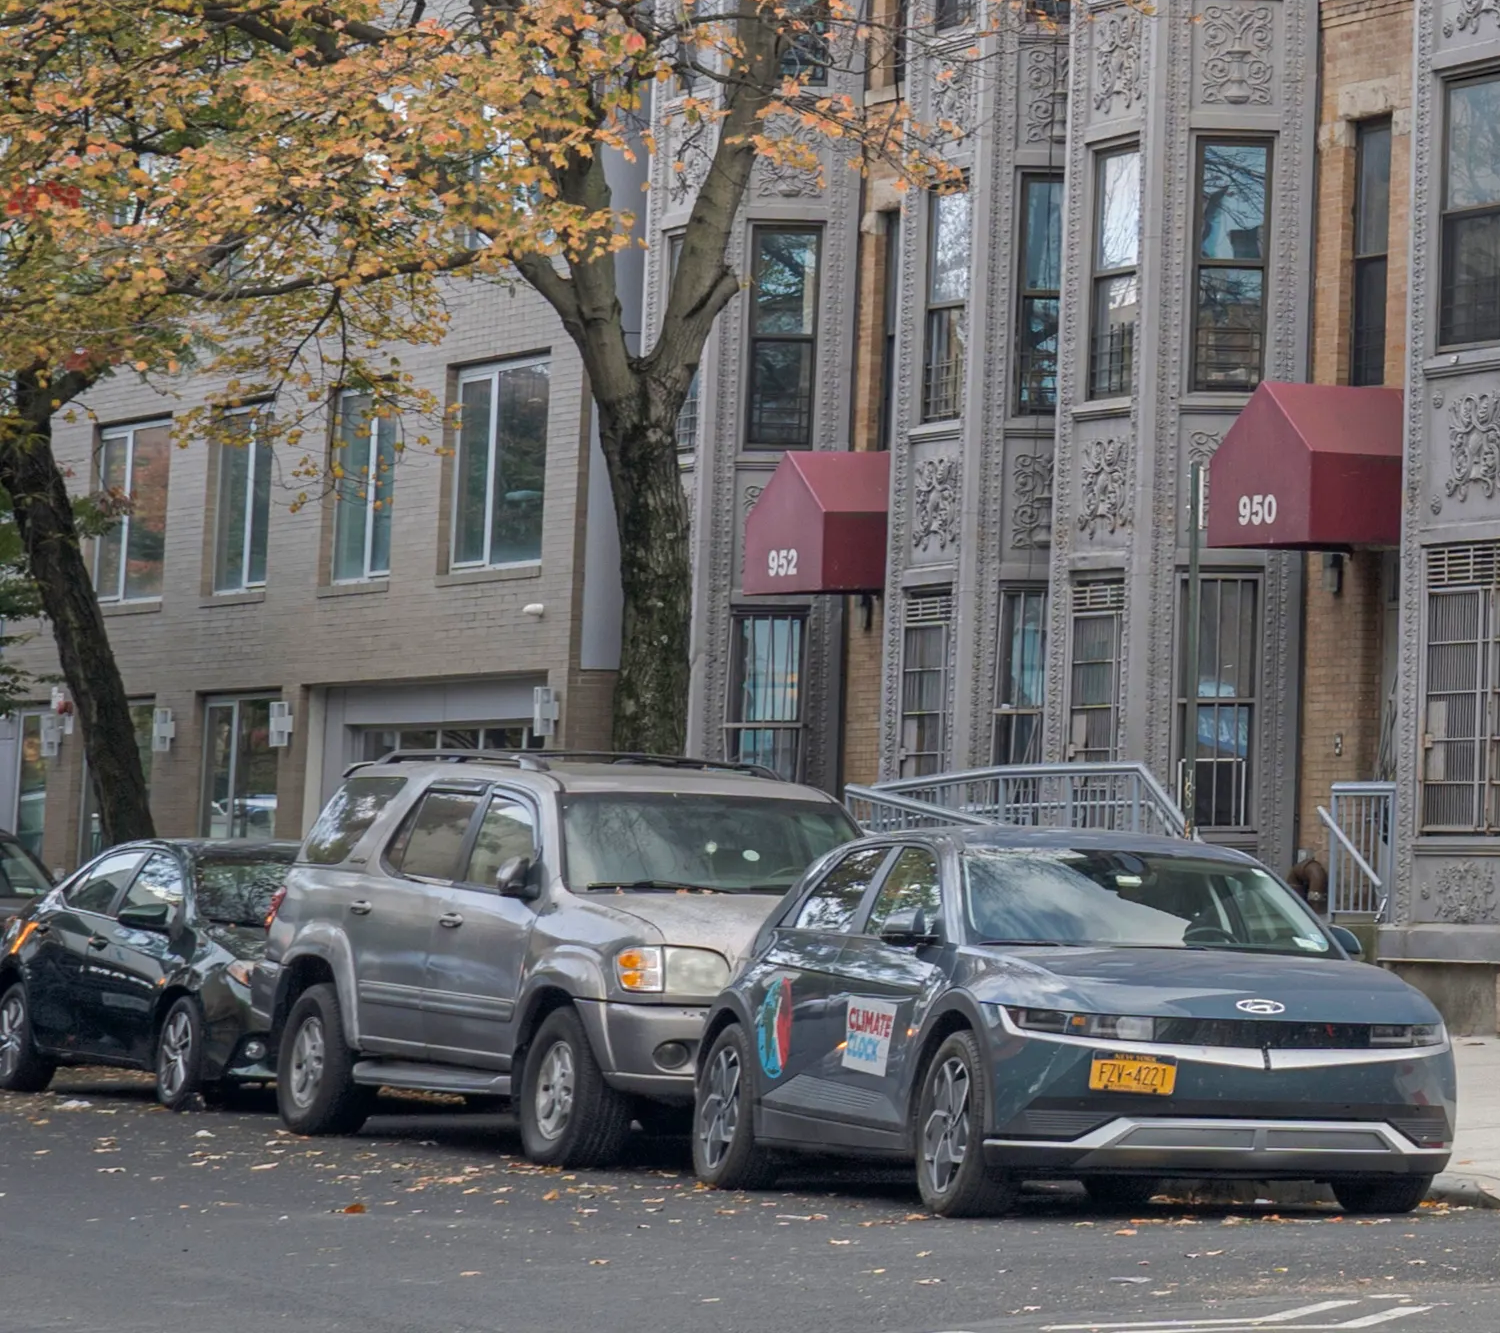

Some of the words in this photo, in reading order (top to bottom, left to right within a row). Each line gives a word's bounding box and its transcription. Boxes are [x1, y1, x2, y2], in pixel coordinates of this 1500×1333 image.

[1238, 494, 1277, 526] 950
[768, 548, 798, 576] 952
[848, 1007, 893, 1039] CLIMATE
[846, 1033, 880, 1063] CLOCK
